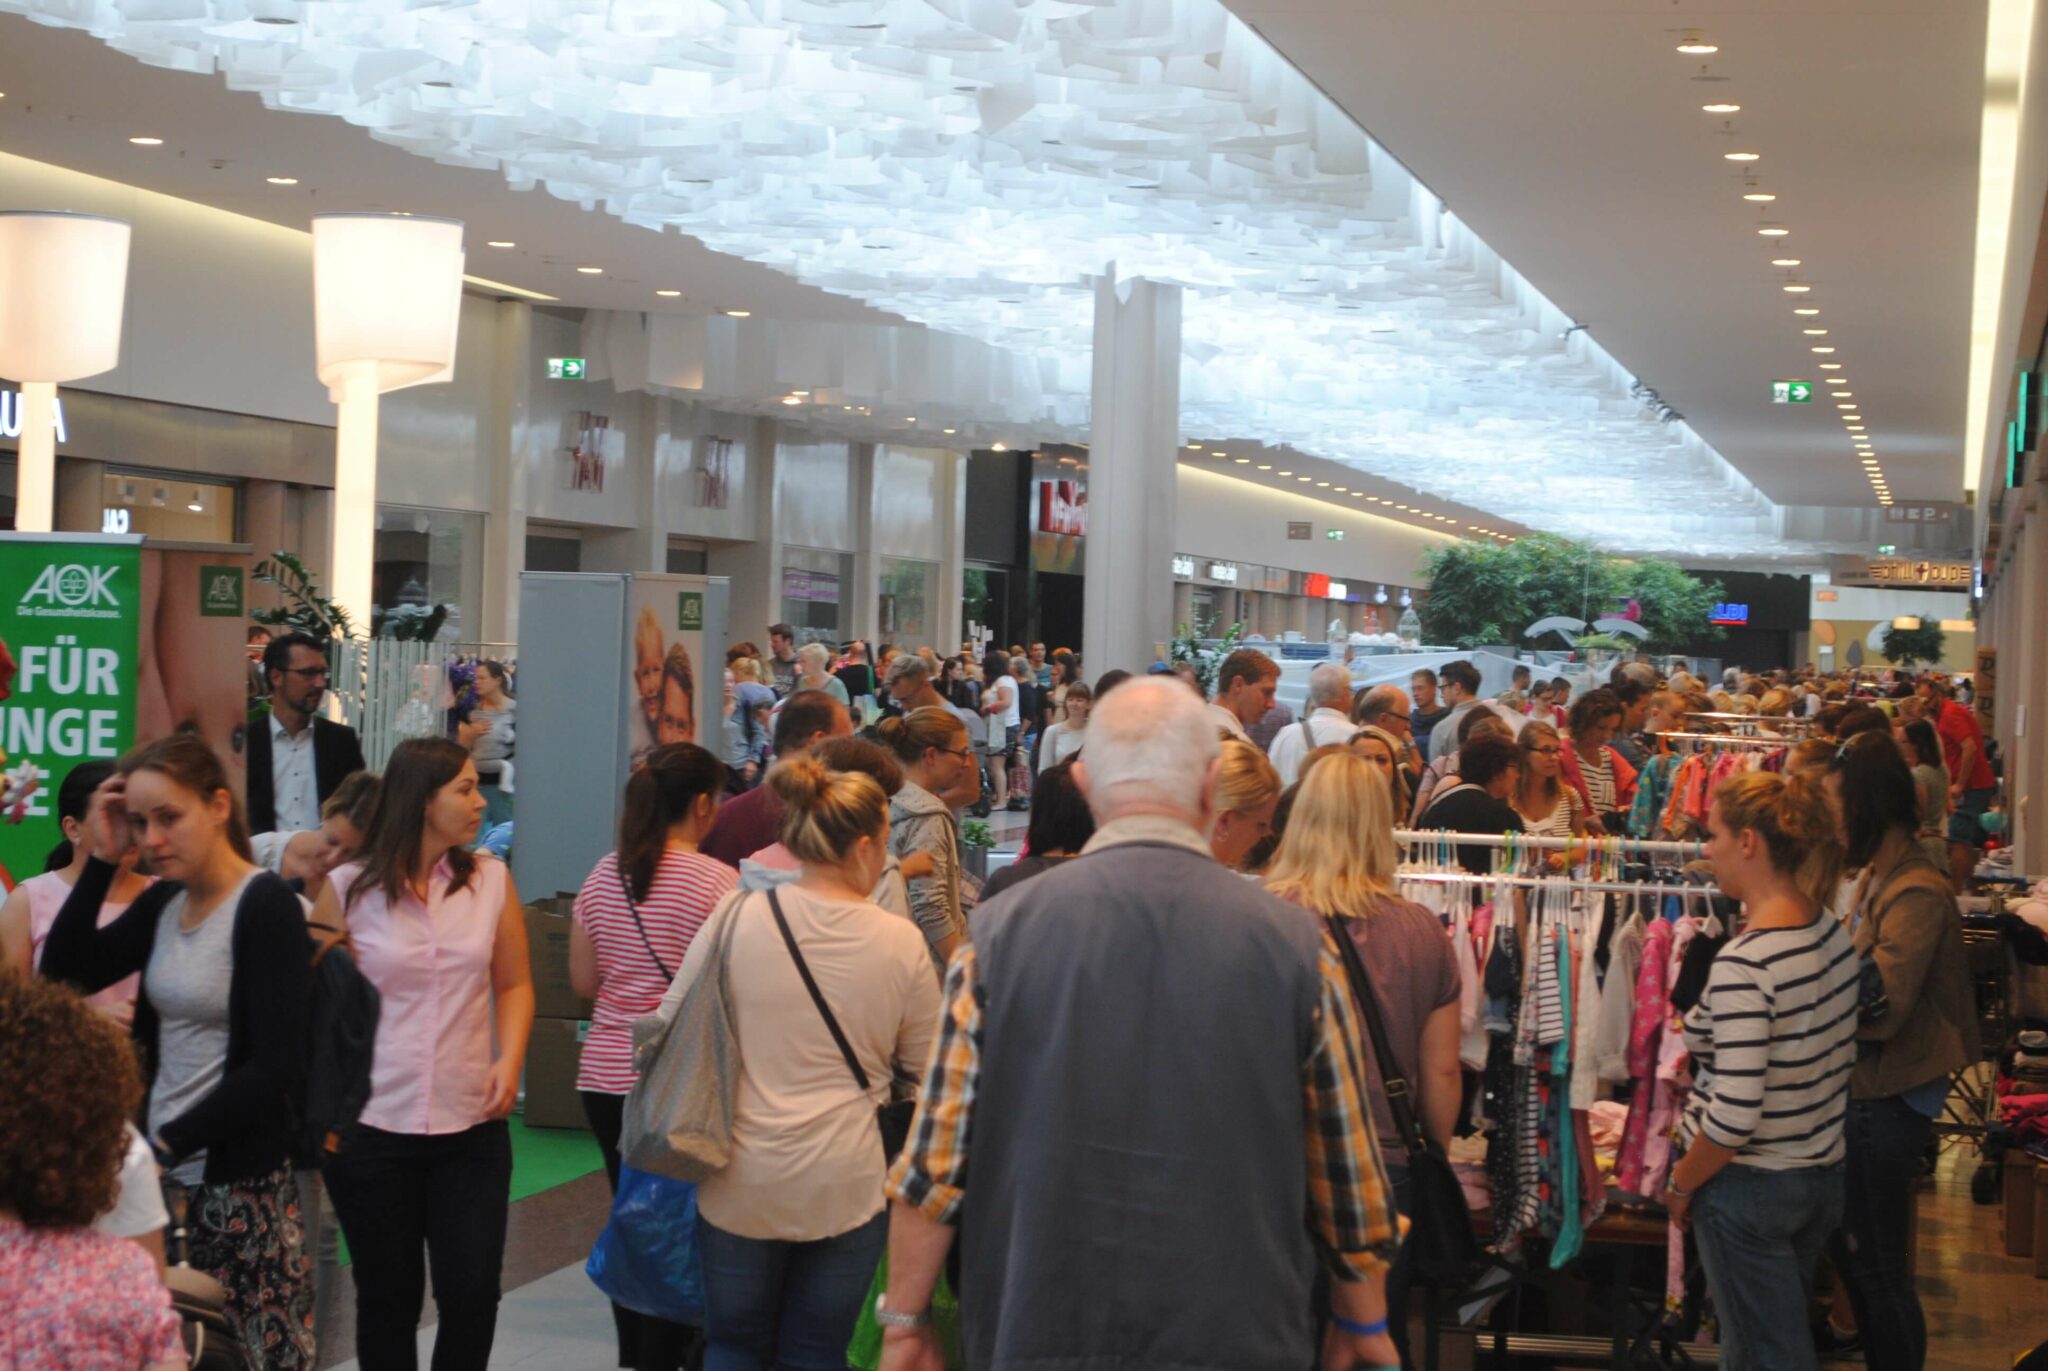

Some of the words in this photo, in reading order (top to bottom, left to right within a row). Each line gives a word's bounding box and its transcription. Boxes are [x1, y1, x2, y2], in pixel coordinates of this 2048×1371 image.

[20, 564, 121, 606] AOK
[19, 635, 120, 695] FÜR
[0, 706, 118, 757] NGE
